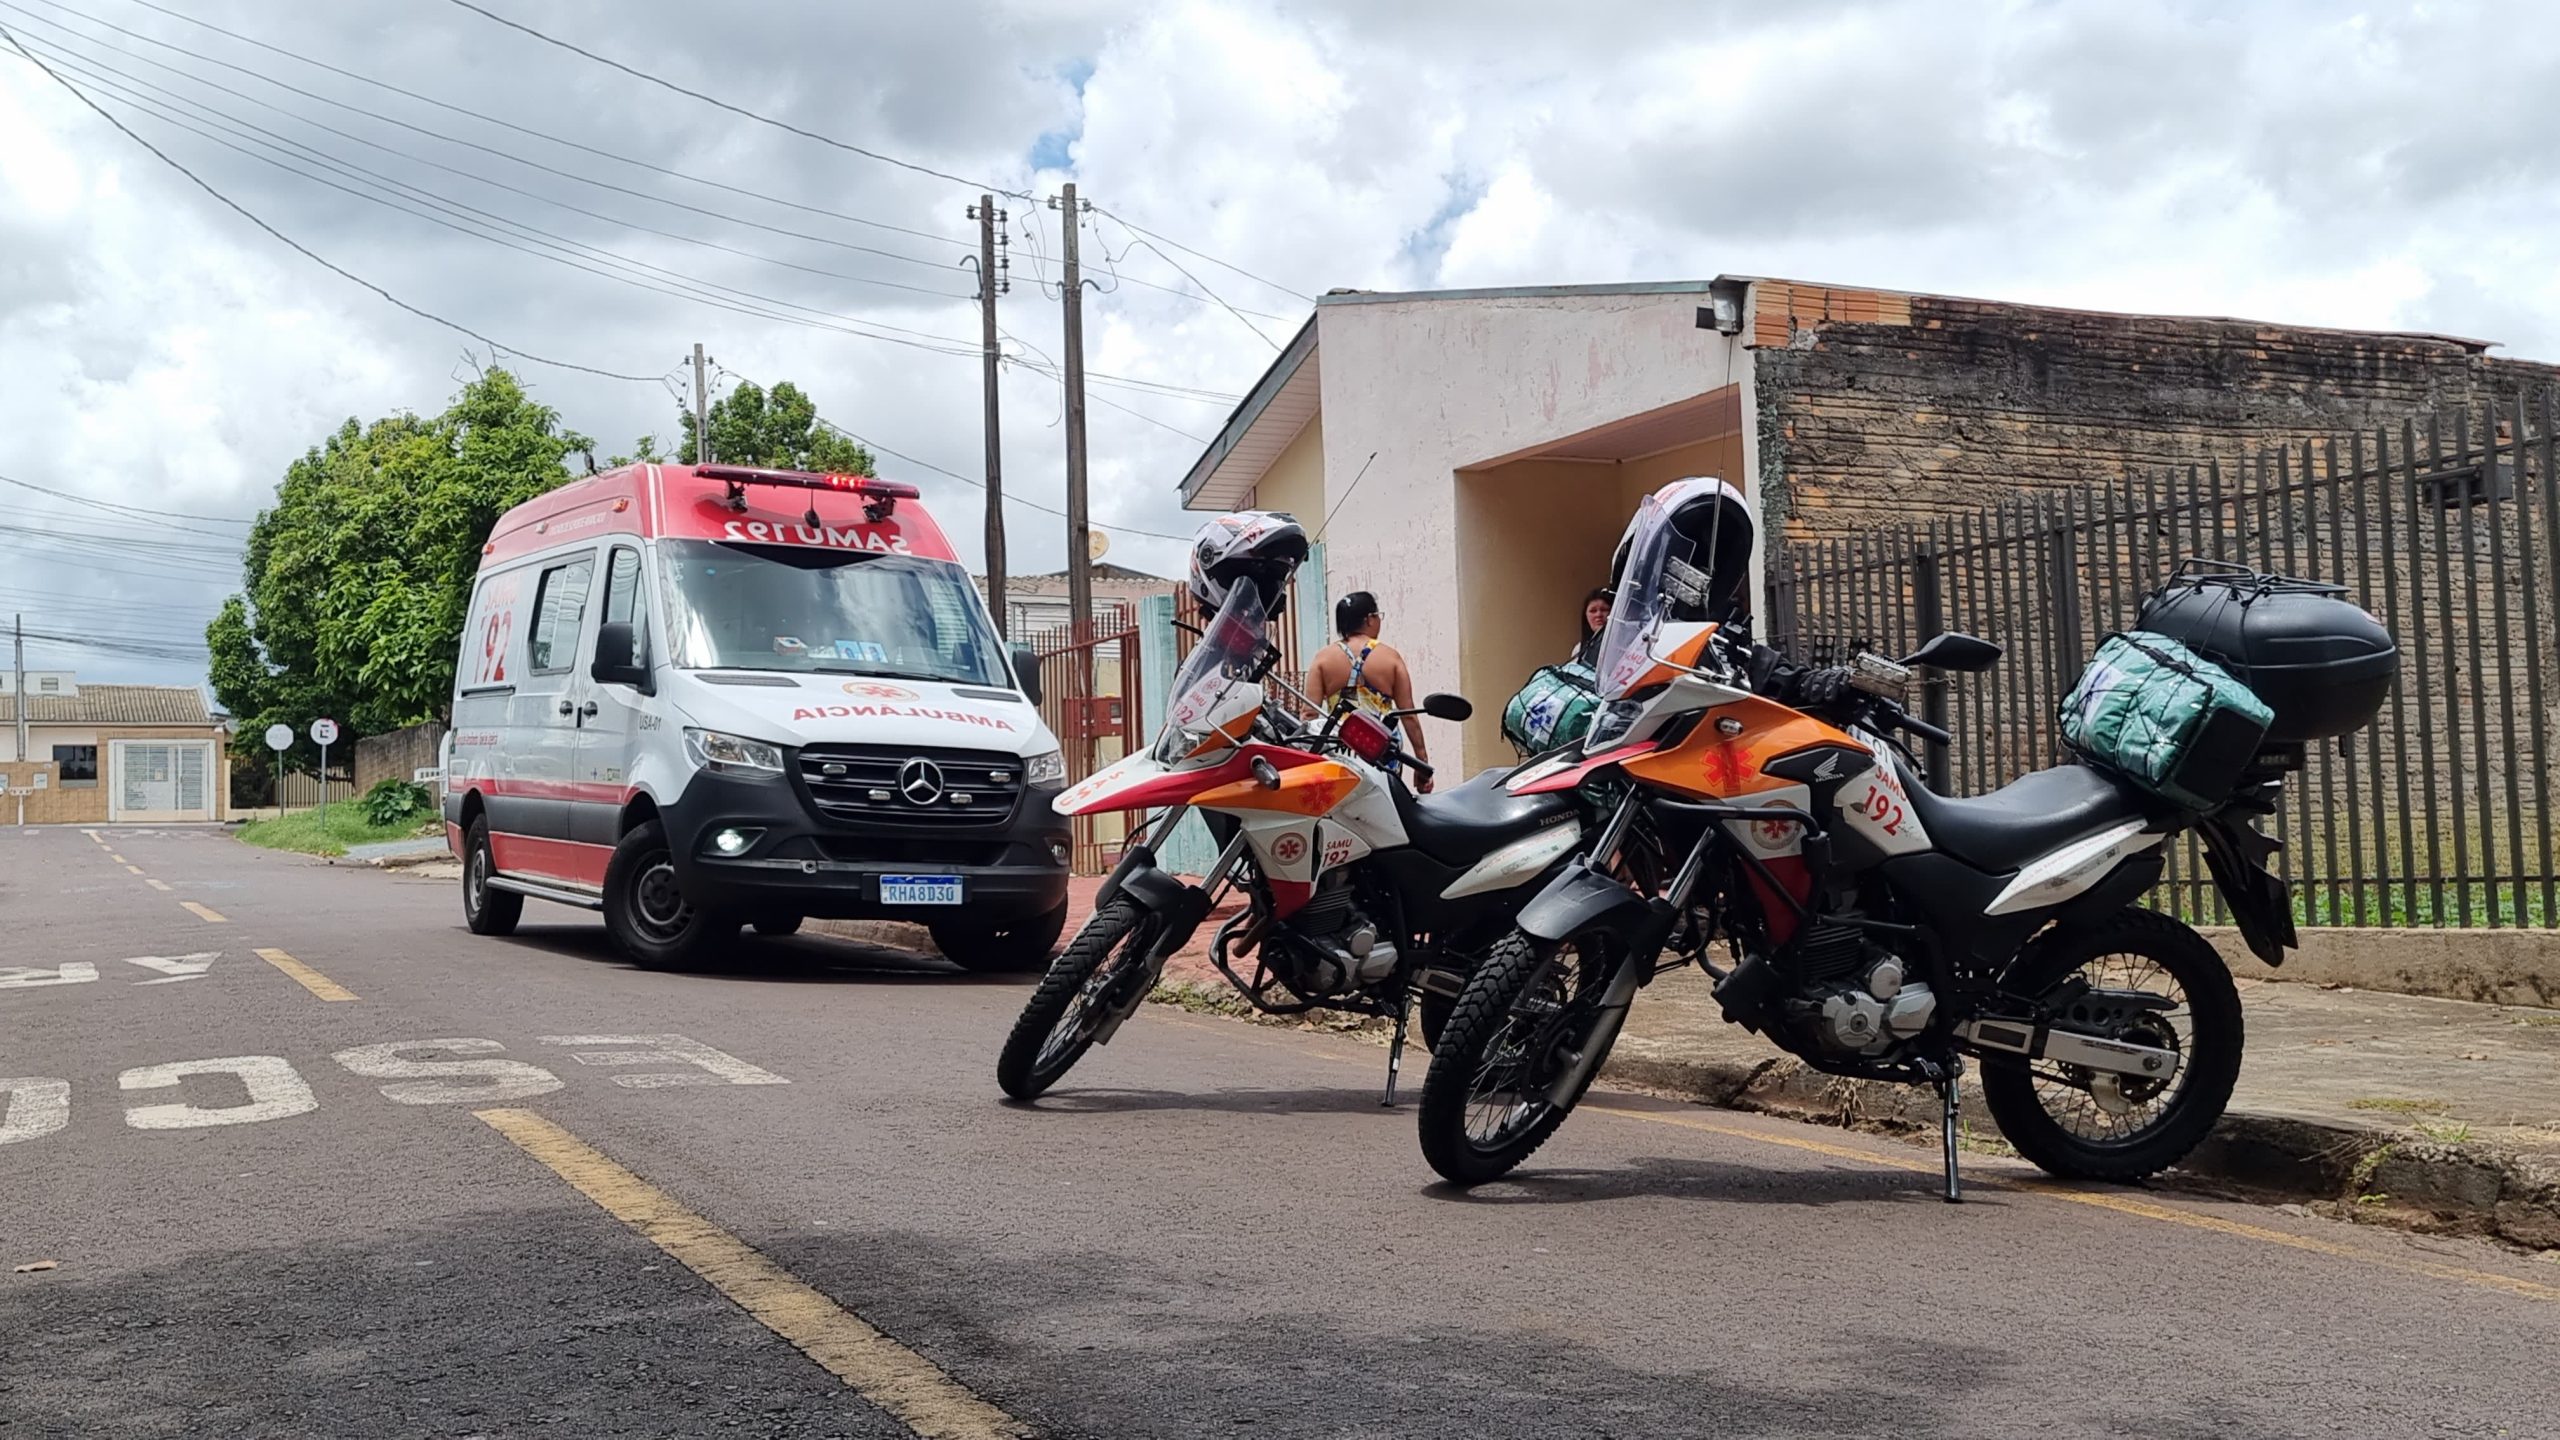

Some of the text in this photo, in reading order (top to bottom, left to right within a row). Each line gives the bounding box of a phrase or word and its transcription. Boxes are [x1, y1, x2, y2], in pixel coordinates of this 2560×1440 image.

[474, 608, 512, 684] 192
[1815, 772, 1845, 783] HONDA
[1875, 765, 1908, 802] SAMU
[1059, 769, 1125, 807] SAMU
[1539, 807, 1581, 827] HONDA
[1861, 785, 1904, 836] 192
[1325, 838, 1353, 851] SAMU
[1321, 850, 1350, 868] 192
[888, 885, 954, 902] RHA8D30
